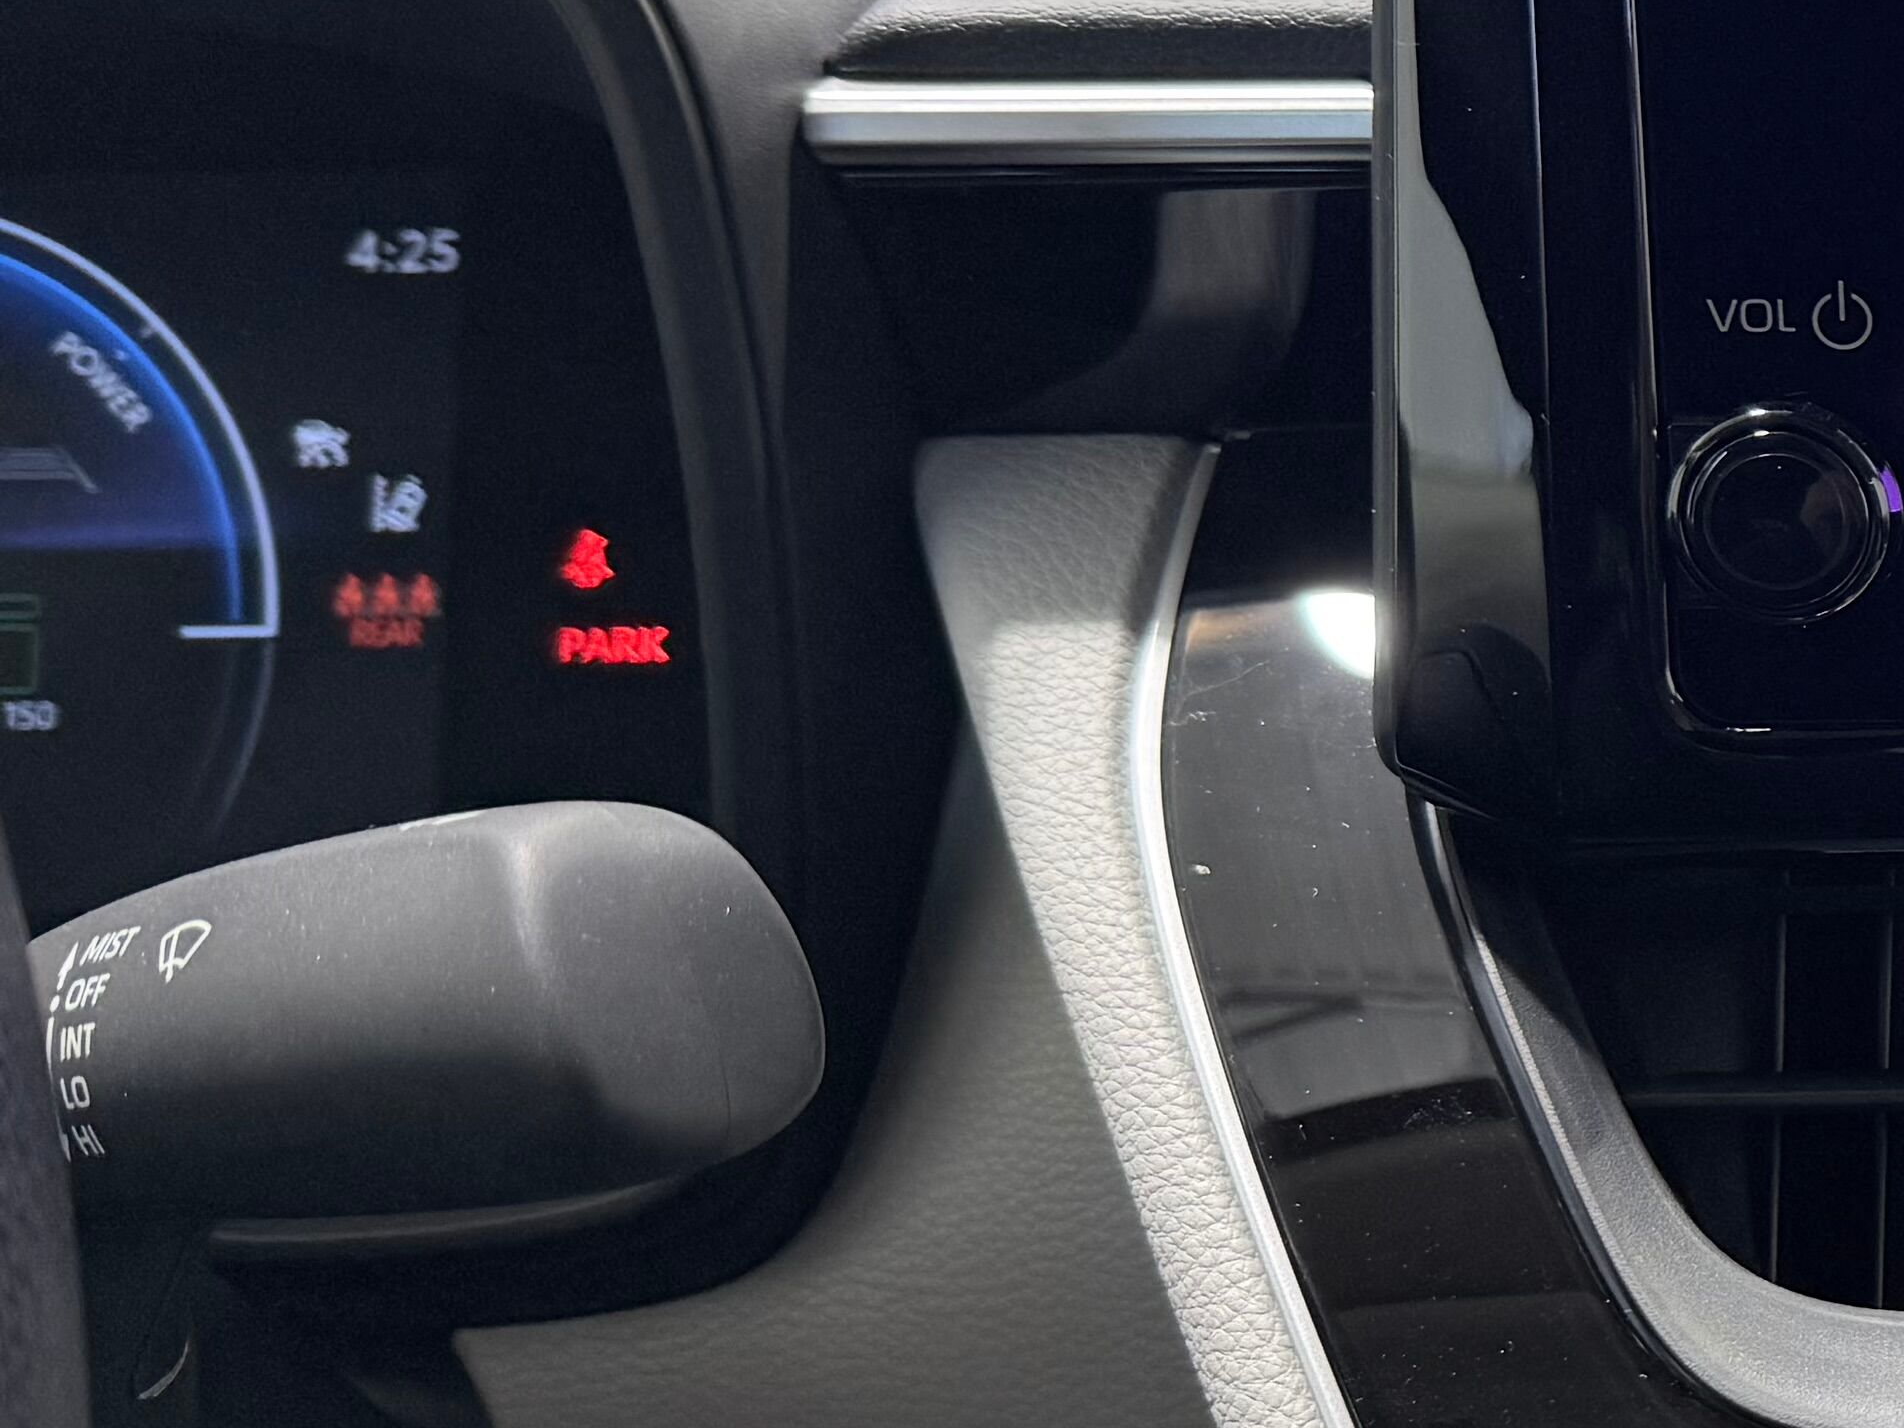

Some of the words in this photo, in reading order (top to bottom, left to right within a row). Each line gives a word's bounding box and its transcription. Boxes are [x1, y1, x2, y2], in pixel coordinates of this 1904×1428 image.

[345, 228, 461, 274] 4:25
[1706, 298, 1797, 333] VOL
[50, 331, 153, 434] POWER
[556, 625, 670, 665] PARK
[3, 699, 60, 731] 150
[79, 925, 141, 966] MIST
[64, 973, 111, 1012] OFF
[60, 1022, 96, 1063] INT
[60, 1075, 91, 1110] LO
[71, 1124, 106, 1157] HI
